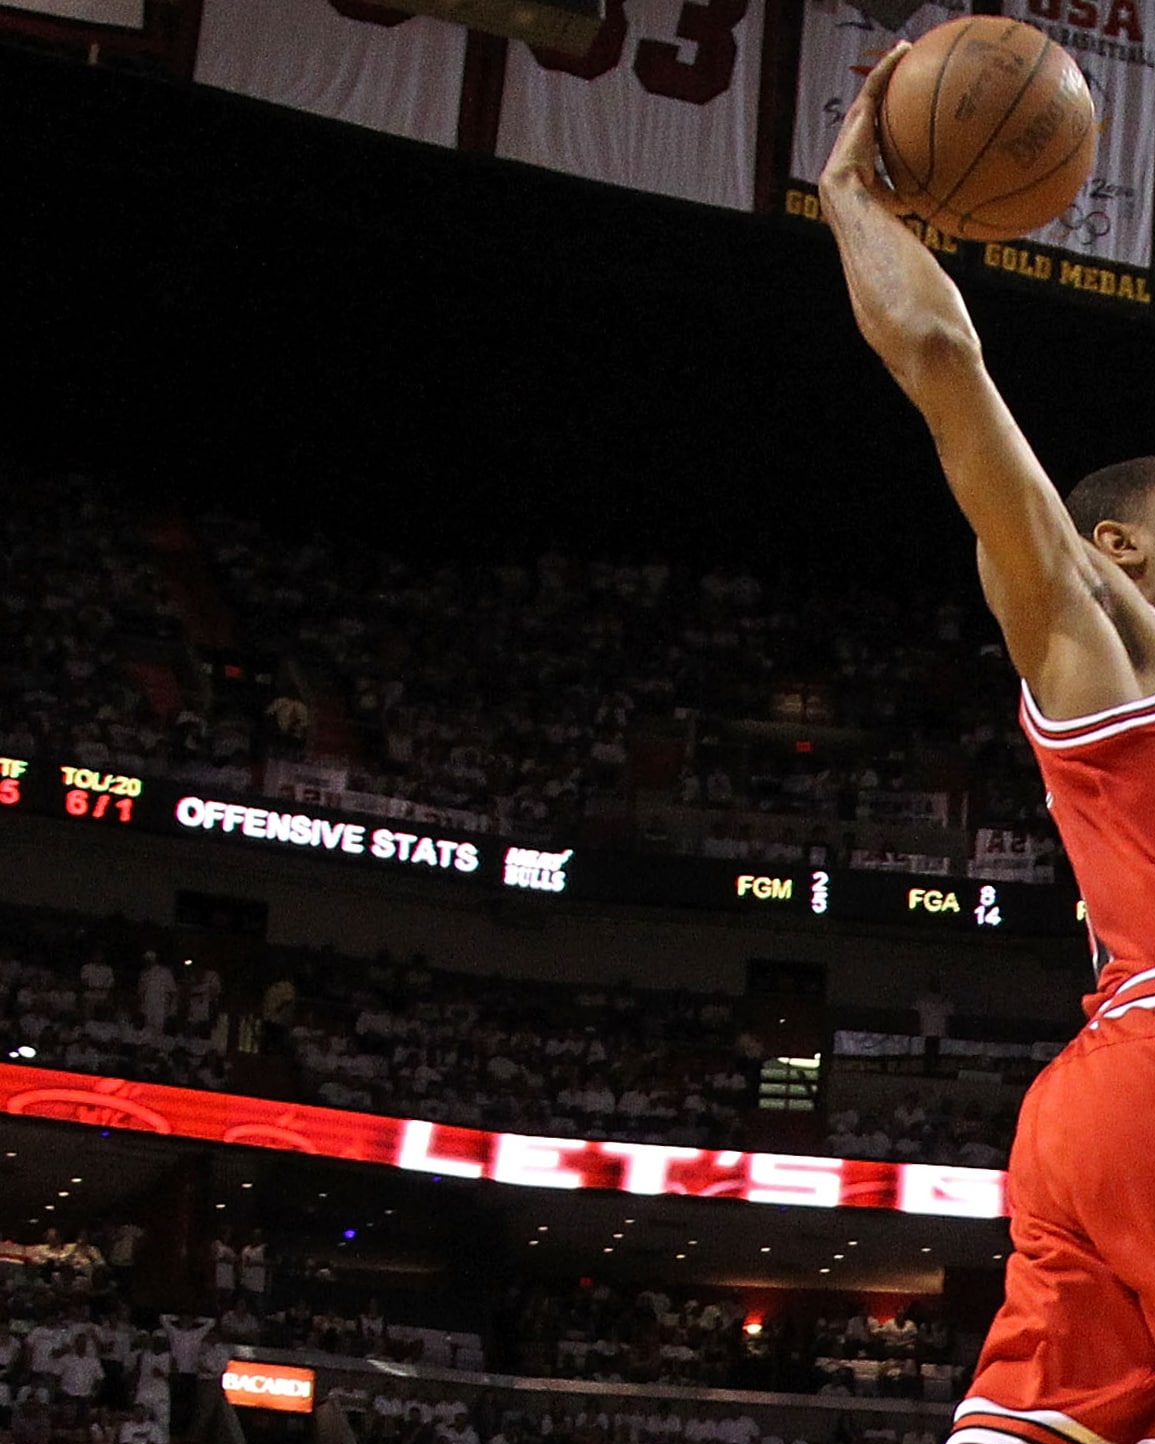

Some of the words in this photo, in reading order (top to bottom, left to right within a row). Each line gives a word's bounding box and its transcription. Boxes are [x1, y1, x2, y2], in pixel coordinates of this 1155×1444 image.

[784, 187, 820, 221] GO
[983, 242, 1051, 281] GOLD
[1058, 259, 1151, 303] MEDAL
[0, 779, 20, 804] 5
[176, 797, 365, 854] OFFENSIVE
[371, 829, 479, 872] STATS
[503, 864, 566, 892] BULLS
[737, 875, 793, 900] FGM
[812, 871, 829, 893] 2
[811, 891, 828, 914] 5
[908, 889, 960, 913] FGA
[979, 886, 996, 906] 8
[974, 906, 1002, 926] 14
[400, 1118, 842, 1208] LET'S
[899, 1163, 1005, 1219] G
[222, 1372, 311, 1398] BACARDI
